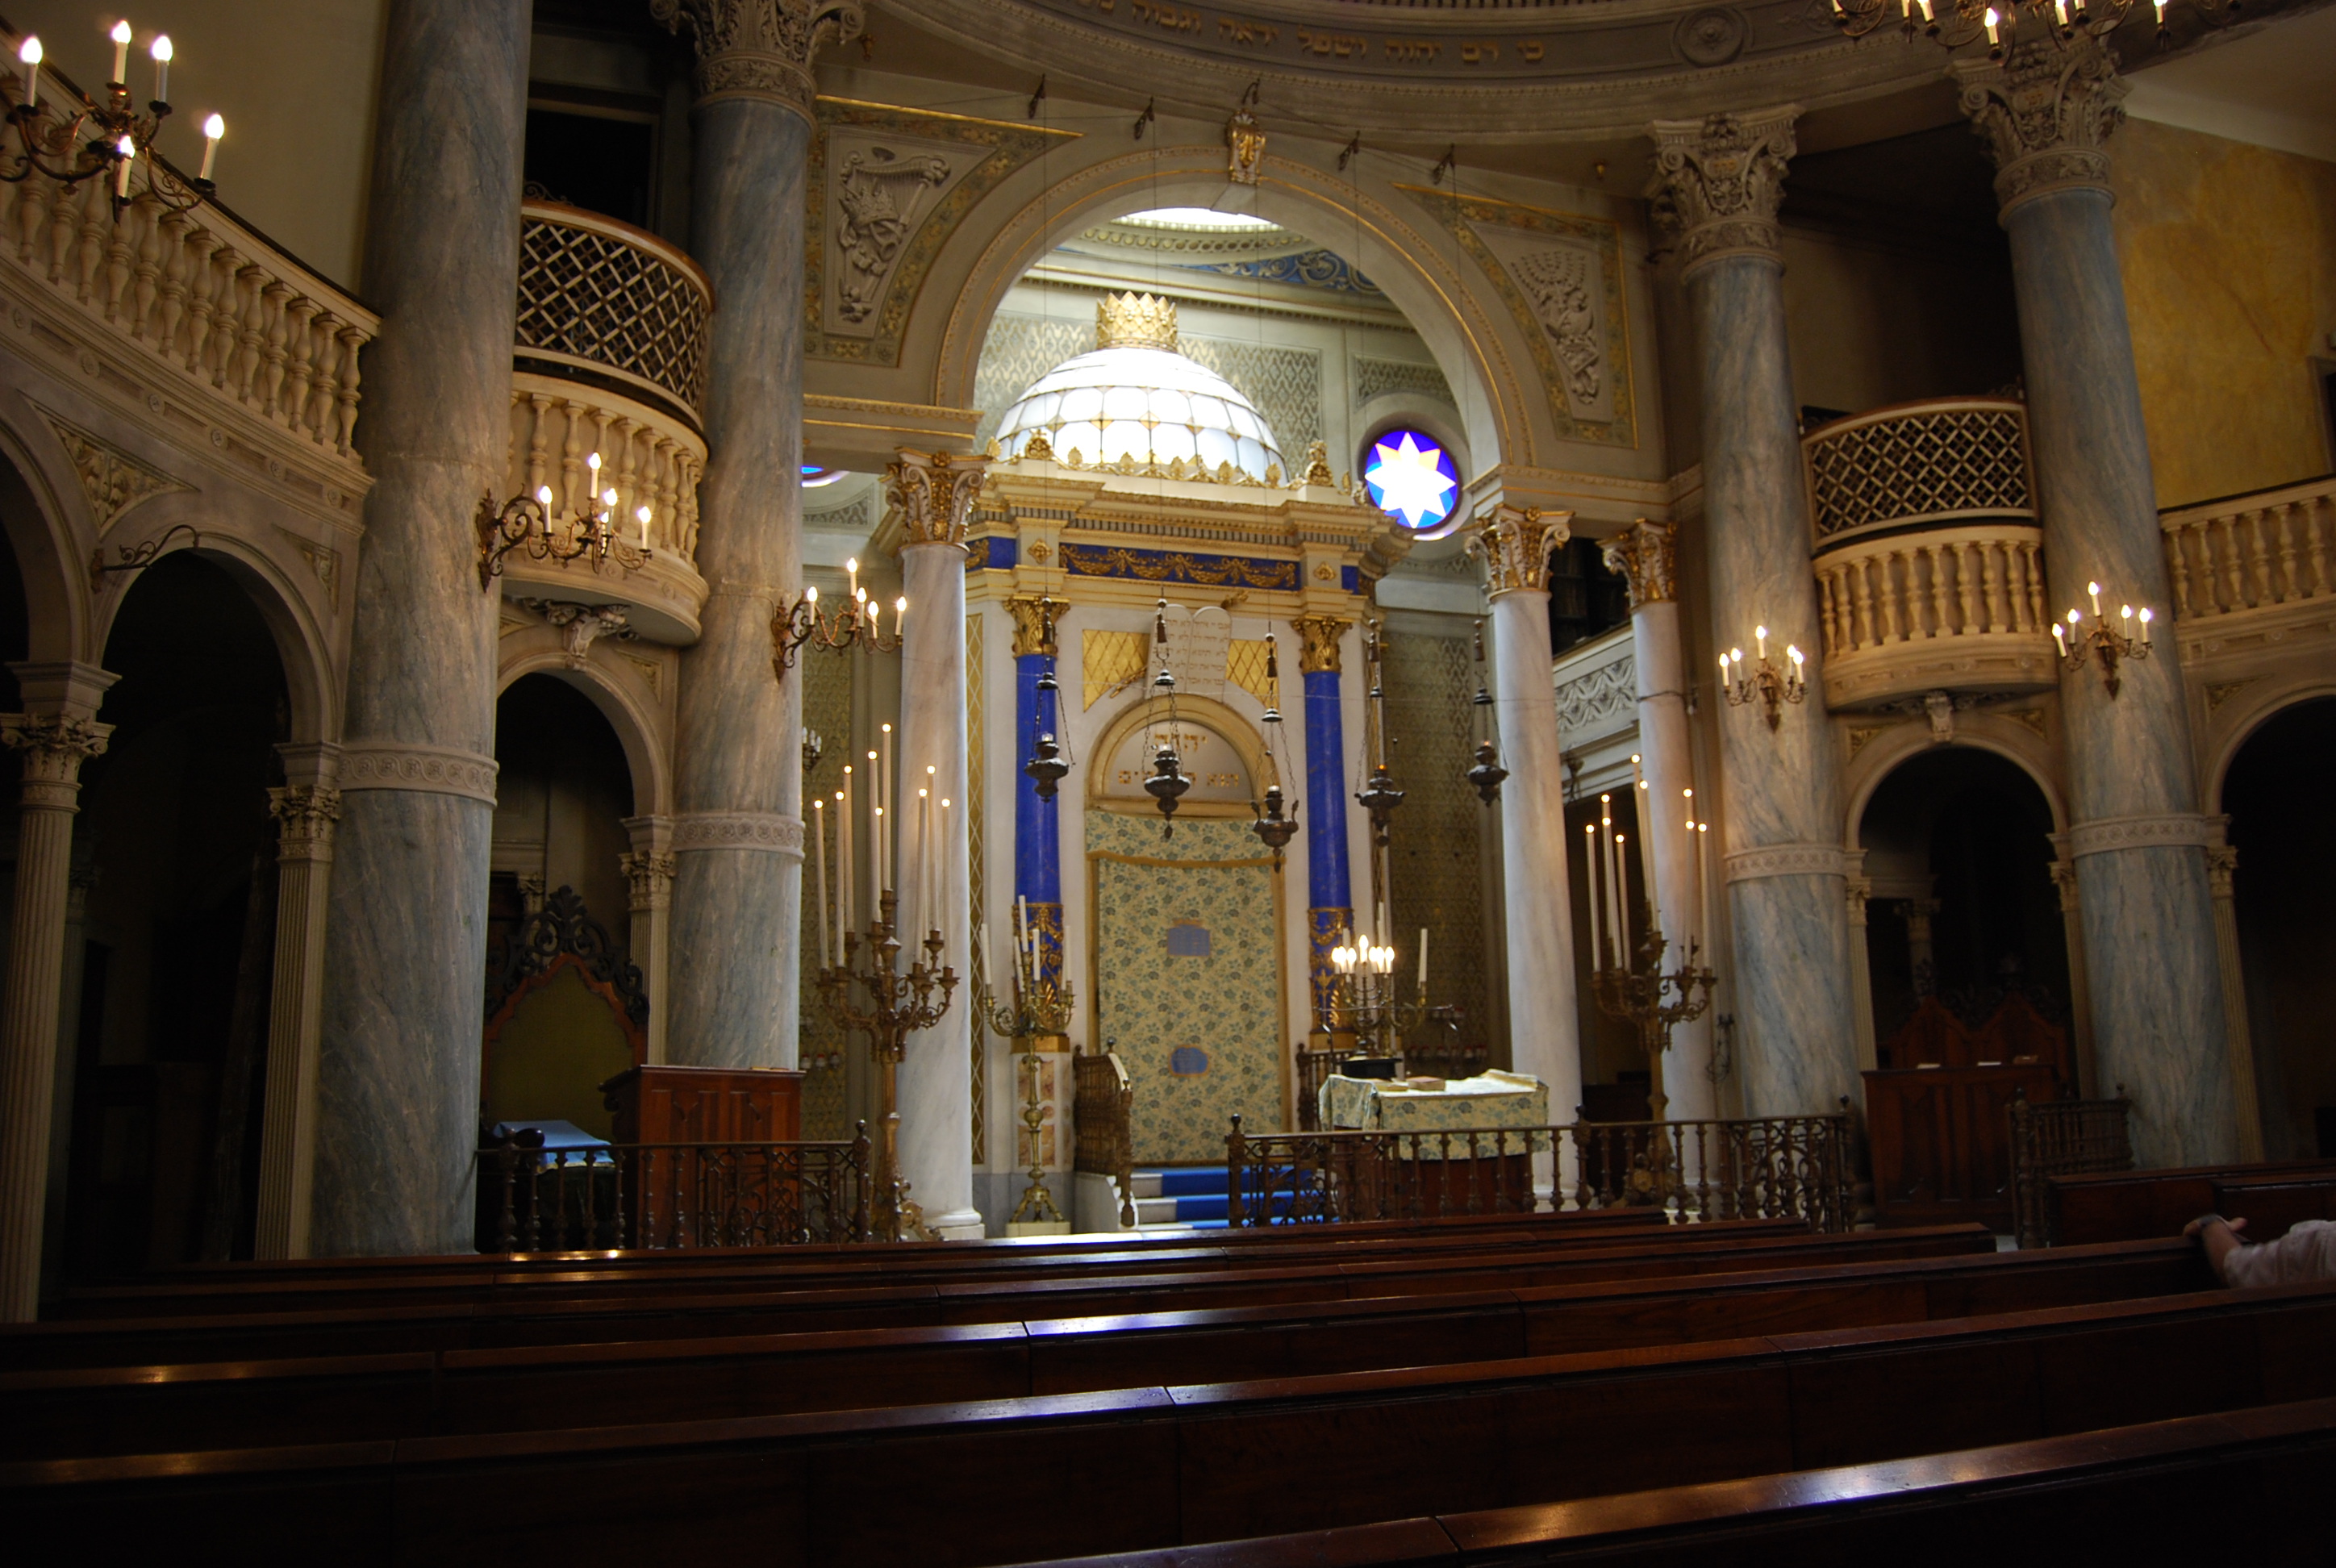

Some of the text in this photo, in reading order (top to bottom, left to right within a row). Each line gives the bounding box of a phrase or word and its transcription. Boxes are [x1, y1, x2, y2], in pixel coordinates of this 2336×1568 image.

[1218, 17, 1281, 46] יראה
[1297, 23, 1368, 58] ושפל
[1385, 40, 1442, 62] יהוה
[1461, 40, 1500, 63] רם
[1517, 40, 1546, 62] כי
[1155, 733, 1208, 752] יהוה
[1207, 772, 1240, 787] הוא
